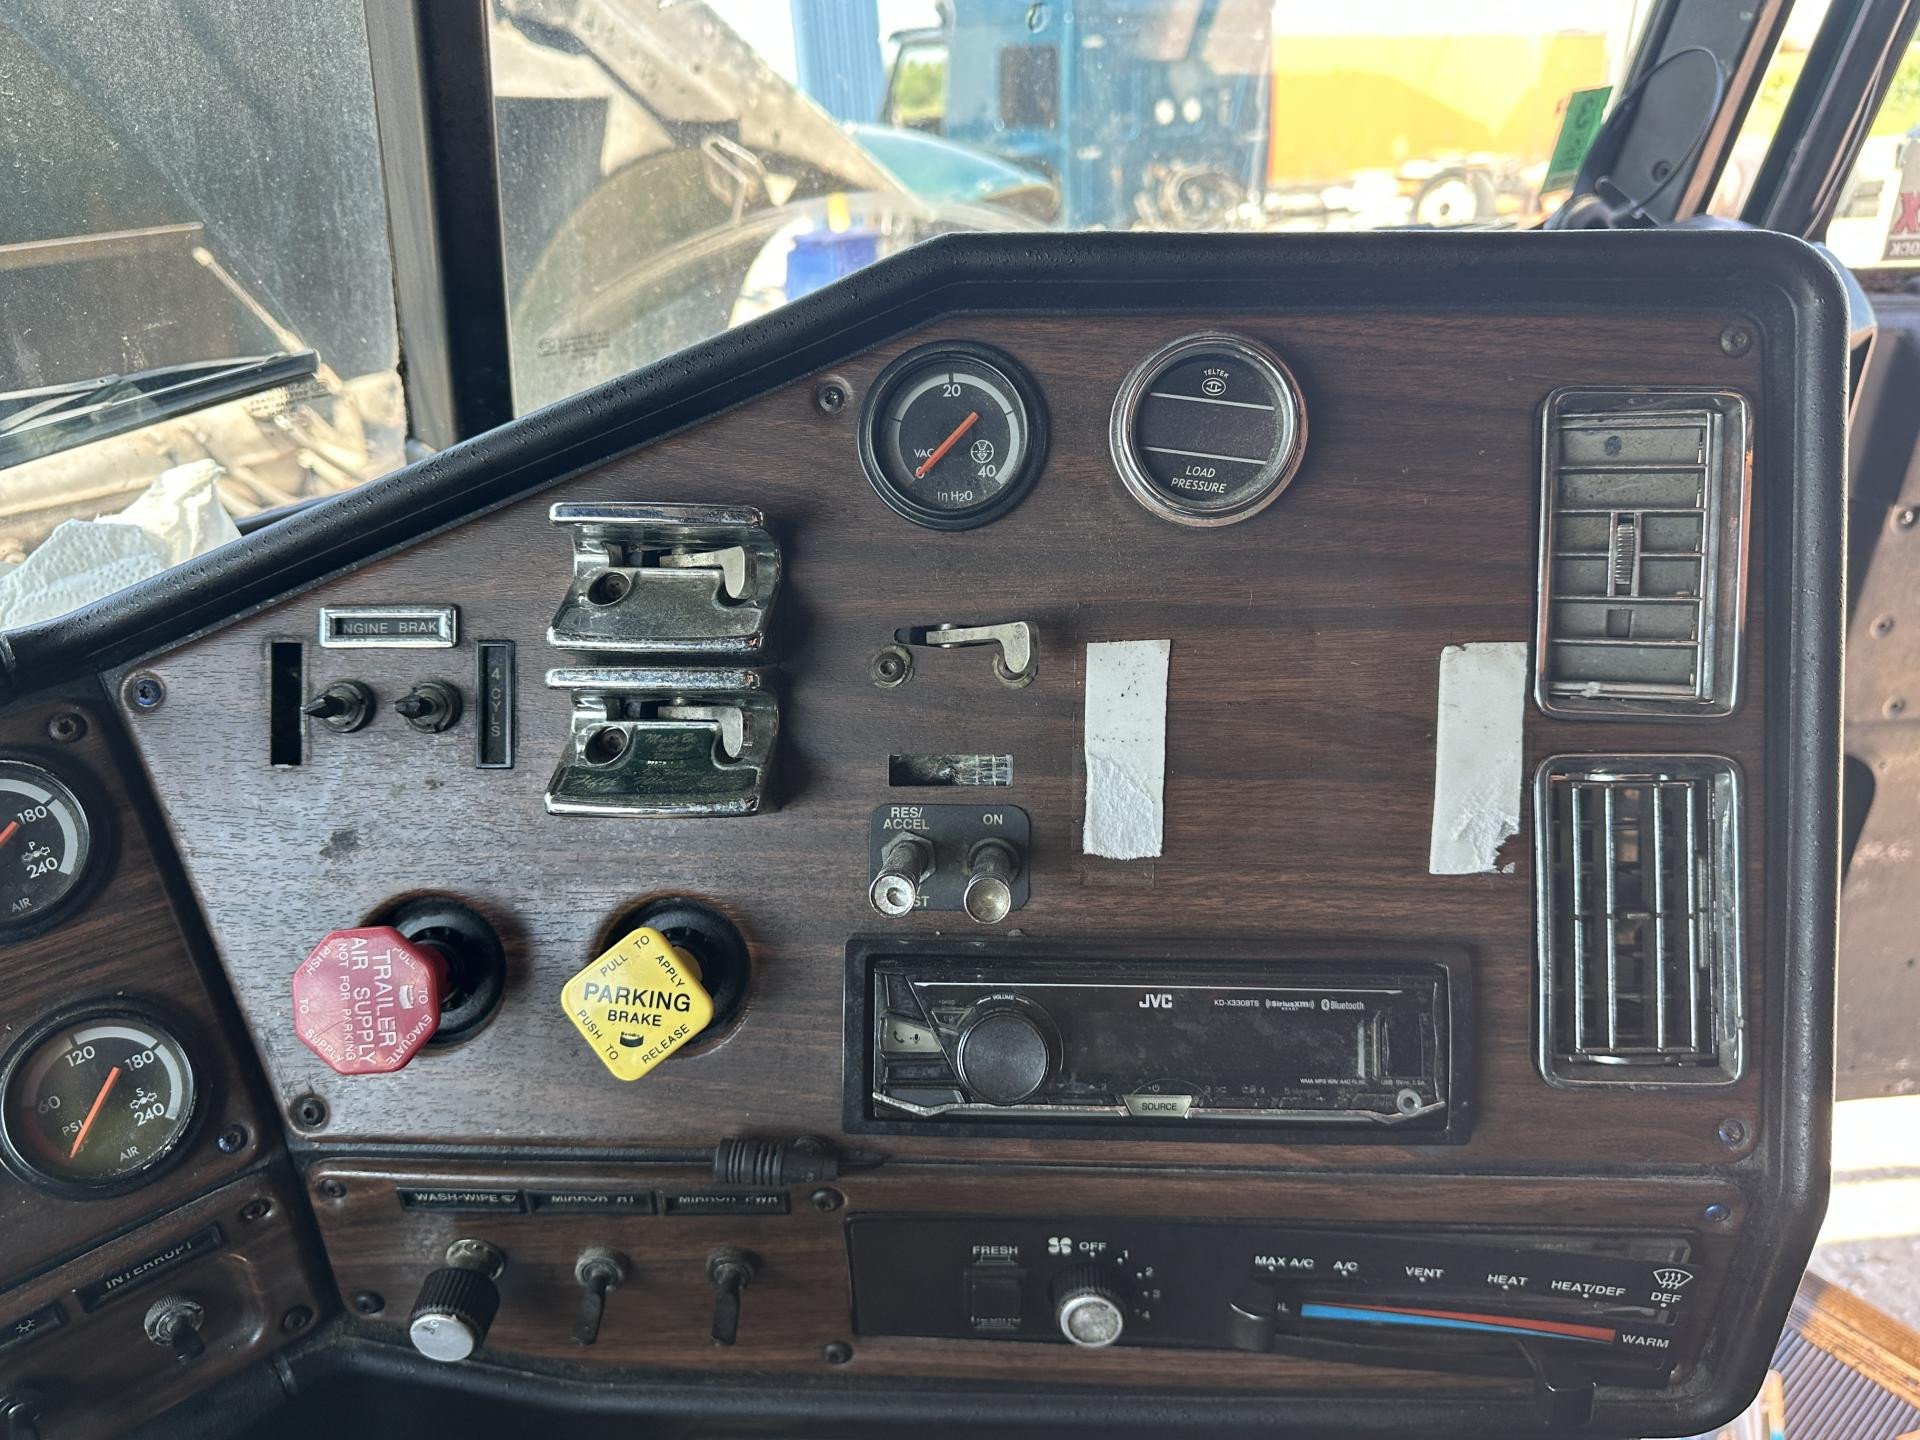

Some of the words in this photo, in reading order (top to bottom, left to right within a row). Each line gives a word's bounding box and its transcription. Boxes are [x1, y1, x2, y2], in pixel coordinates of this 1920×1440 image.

[1203, 369, 1229, 379] TELTEK
[943, 384, 961, 397] 20
[913, 448, 935, 458] VAC
[977, 464, 996, 478] 40
[1185, 465, 1216, 478] LOAD
[1170, 477, 1227, 493] PRESSURE
[343, 622, 388, 634] NGINE
[399, 621, 438, 633] BRAK
[491, 667, 501, 680] 4
[17, 805, 47, 825] 180
[890, 806, 923, 818] RES/
[982, 813, 1003, 825] ON
[882, 818, 930, 830] ACCEL
[28, 841, 36, 851] P
[26, 857, 58, 879] 240
[11, 897, 32, 912] AIR
[306, 945, 332, 976] PUSH
[337, 943, 349, 968] NOT
[351, 937, 369, 970] AIR
[600, 954, 628, 977] PULL
[633, 935, 650, 950] TO
[655, 954, 685, 988] APPLY
[339, 975, 350, 1000] FOR
[372, 950, 398, 1048] TRAILER
[418, 987, 429, 1004] TO
[583, 982, 691, 1013] PARKING
[1139, 993, 1173, 1009] JVC
[300, 997, 310, 1015] TO
[1330, 1001, 1365, 1010] Bluetooth
[353, 987, 377, 1064] SUPPLY
[608, 1009, 662, 1027] BRAKE
[341, 1008, 357, 1061] PARKING
[386, 1013, 433, 1066] EVACUATE
[576, 1009, 603, 1040] PUSH
[604, 1044, 619, 1061] TO
[641, 1023, 691, 1065] RELEASE
[305, 1028, 344, 1063] SUPPLY
[65, 1045, 96, 1067] 120
[124, 1050, 155, 1072] 180
[136, 1088, 144, 1097] S
[38, 1095, 61, 1114] 60
[1141, 1102, 1177, 1111] SOURCE
[134, 1102, 165, 1127] 240
[61, 1119, 83, 1137] PSI
[119, 1146, 140, 1162] AIR
[415, 1193, 499, 1202] WASH-WIPE
[972, 1245, 1018, 1255] FRESH
[1079, 1241, 1107, 1251] OFF
[1123, 1250, 1128, 1259] 1
[1254, 1255, 1286, 1267] MAX
[1289, 1258, 1314, 1269] A/C
[1145, 1266, 1153, 1276] 2
[1333, 1260, 1358, 1272] A/C
[1405, 1266, 1444, 1278] VENT
[1487, 1273, 1528, 1286] HEAT
[1152, 1289, 1160, 1298] 3
[1551, 1280, 1626, 1297] HEAT/DEF
[1650, 1291, 1682, 1303] DEF
[1621, 1333, 1669, 1348] WARM
